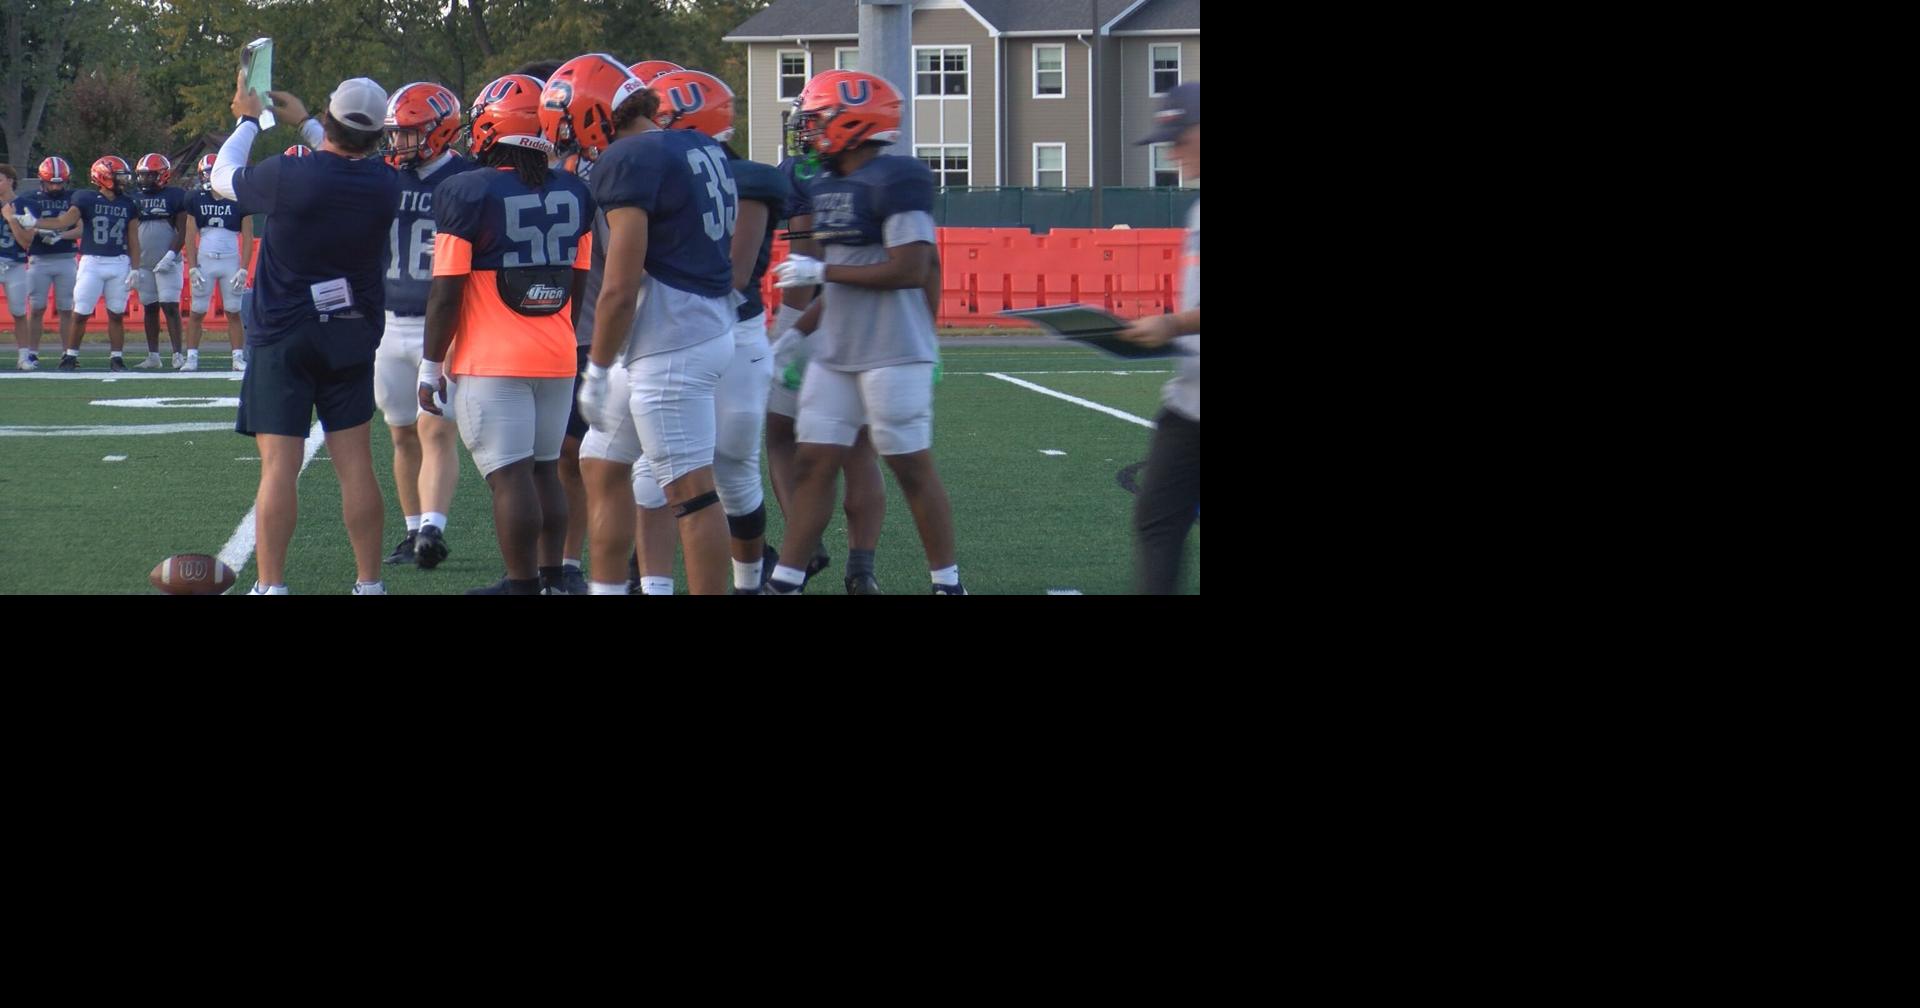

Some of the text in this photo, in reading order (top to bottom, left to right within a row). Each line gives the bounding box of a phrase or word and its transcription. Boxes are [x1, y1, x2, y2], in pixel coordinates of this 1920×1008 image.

[426, 91, 455, 118] U
[484, 79, 517, 104] U
[669, 82, 705, 114] U
[837, 79, 872, 106] U
[399, 190, 433, 212] TIC
[686, 145, 738, 241] 35
[95, 204, 128, 218] UTICA
[200, 204, 232, 216] UTICA
[92, 215, 126, 245] 84
[503, 190, 580, 268] 52
[528, 285, 563, 300] UTICA
